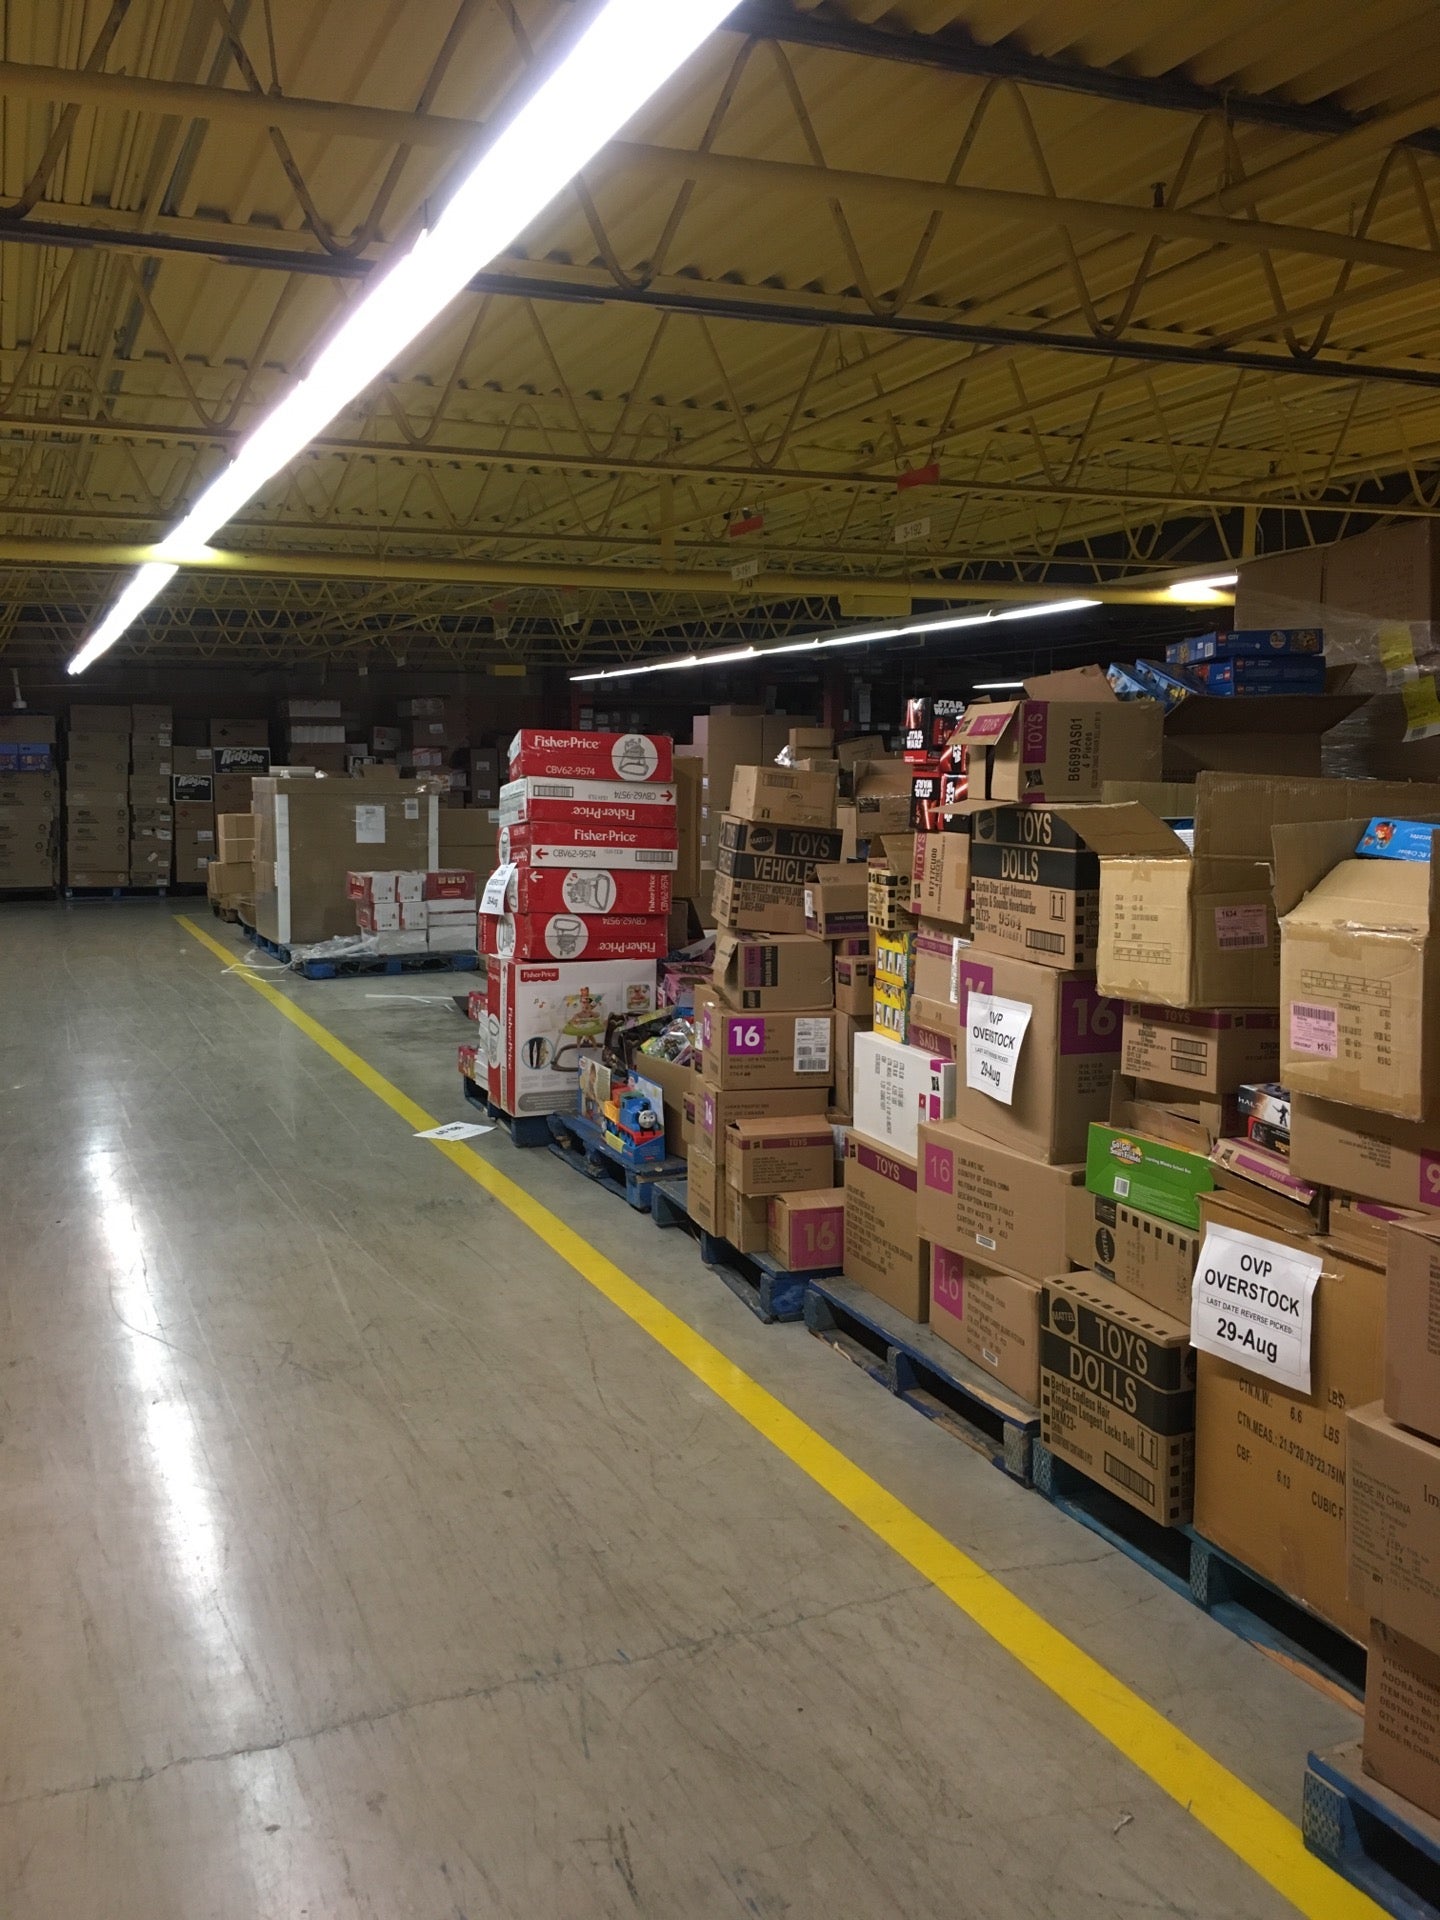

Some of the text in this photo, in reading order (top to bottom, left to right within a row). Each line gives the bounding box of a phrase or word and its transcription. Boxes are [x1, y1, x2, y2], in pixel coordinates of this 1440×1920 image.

[534, 735, 601, 749] Fisher-Price
[906, 739, 923, 749] WARS
[907, 730, 923, 740] STAR
[1027, 713, 1043, 751] TOYS
[220, 749, 265, 765] Ridgies
[545, 765, 596, 776] CBV62-9574
[571, 806, 636, 820] Fisher-Price
[574, 829, 638, 842] Fisher-Price
[1017, 811, 1052, 845] TOYS
[552, 849, 596, 858] CBV62-9574
[790, 832, 831, 858] TOYS
[915, 833, 925, 872] TOYS
[753, 857, 816, 883] VEHICLE
[1001, 849, 1039, 882] DOLLS
[599, 940, 656, 952] Fisher-Price
[1072, 998, 1117, 1036] 16
[1164, 1009, 1191, 1024] TOYS
[732, 1025, 761, 1047] 16
[919, 1030, 940, 1052] TOYS
[875, 1154, 901, 1181] TOYS
[930, 1155, 951, 1183] 16
[1270, 1170, 1286, 1181] TOYS
[803, 1220, 837, 1252] 16
[1240, 1254, 1272, 1278] OVP
[937, 1257, 960, 1302] 16
[1204, 1268, 1300, 1317] OVERSTOCK
[1052, 1309, 1075, 1322] MATTEL
[1206, 1297, 1222, 1308] LAST
[1222, 1301, 1239, 1314] DATE
[1240, 1305, 1269, 1326] REVERSE
[1095, 1315, 1148, 1375] TOYS
[1216, 1317, 1278, 1364] 29-Aug
[1070, 1345, 1137, 1413] DOLLS
[1051, 1377, 1110, 1419] Barbie Endless Hair
[1052, 1392, 1135, 1450] Kingdom Longest Locks Doll
[1289, 1406, 1303, 1424] 6.6
[1323, 1423, 1341, 1445] LBS
[1311, 1490, 1337, 1517] CUBIC
[1385, 1493, 1411, 1516] CHINA
[1380, 1682, 1400, 1698] ITEM
[1379, 1695, 1436, 1734] DESTINATION
[1378, 1723, 1401, 1743] MADE
[1403, 1738, 1412, 1749] IN
